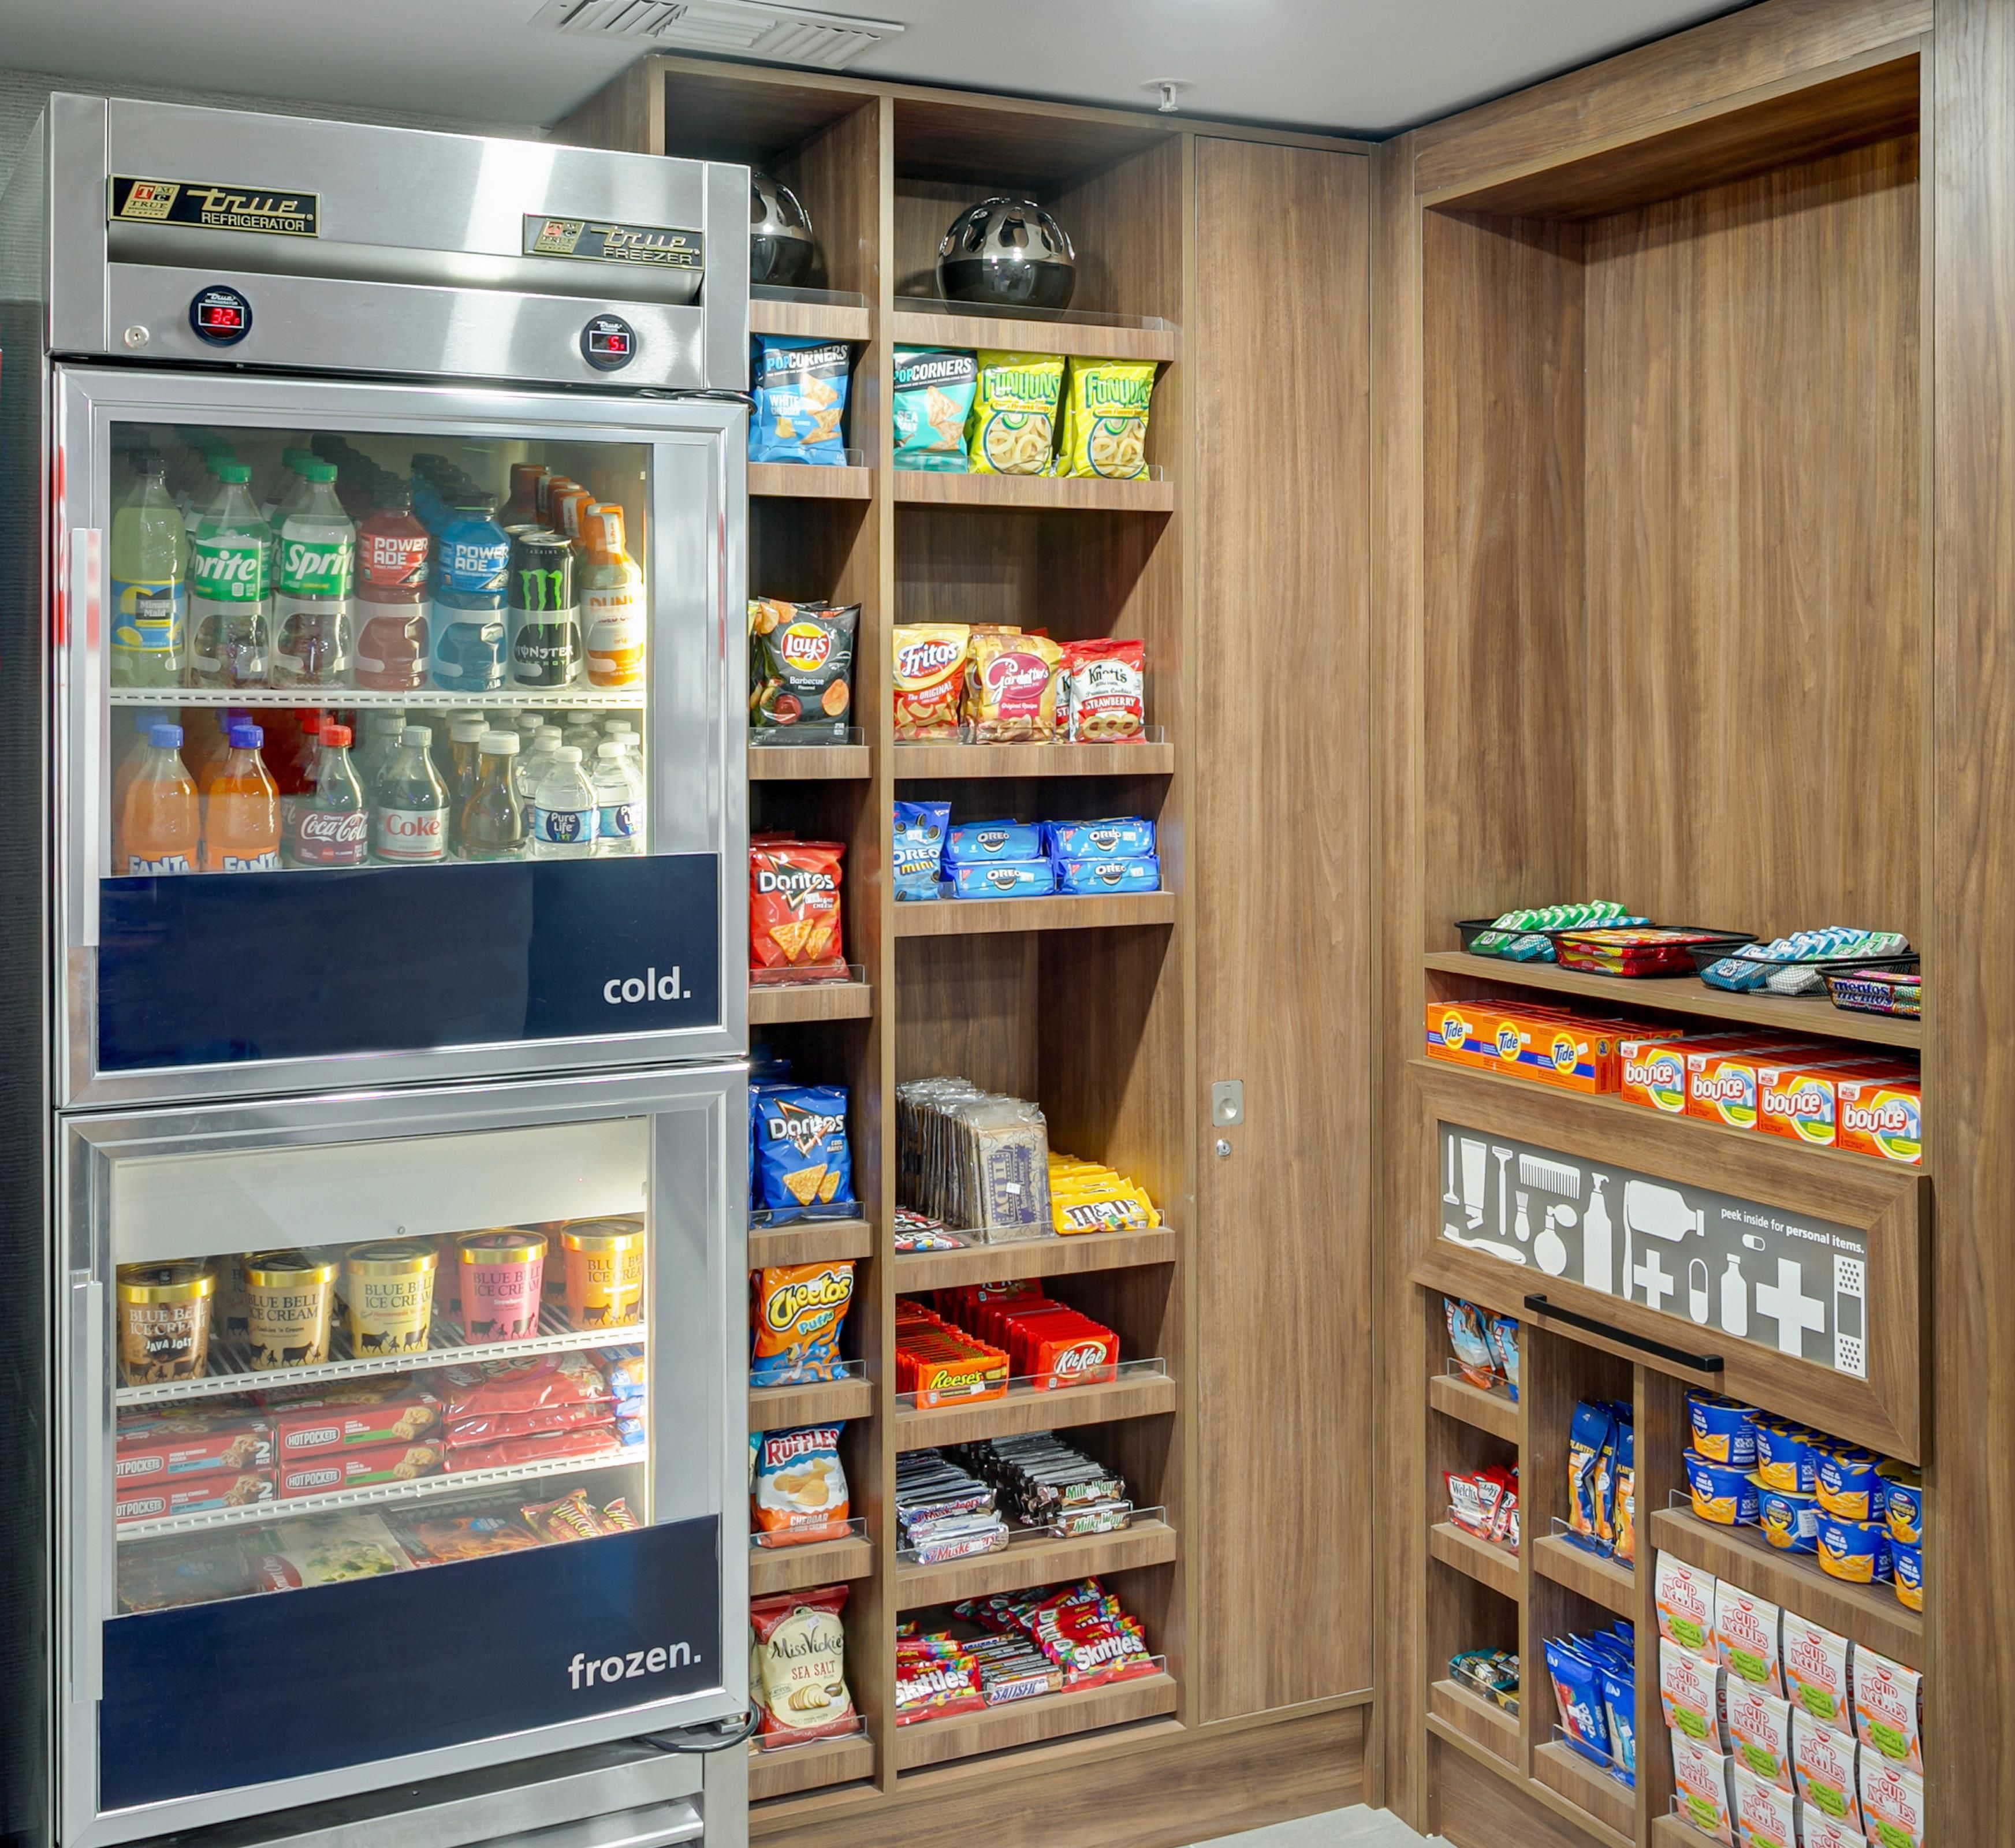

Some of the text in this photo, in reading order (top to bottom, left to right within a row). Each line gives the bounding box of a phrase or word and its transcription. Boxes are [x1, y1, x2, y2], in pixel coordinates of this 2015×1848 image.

[131, 201, 167, 209] TRUE
[201, 211, 305, 232] REFRIGERATOR
[603, 247, 692, 264] FREEZER
[766, 345, 848, 371] POPCORNERS
[897, 411, 918, 423] SEA
[374, 538, 428, 552] POWER
[374, 551, 407, 565] ADE
[455, 557, 487, 572] ADE
[140, 601, 170, 610] Minute
[143, 609, 166, 618] Maid
[785, 635, 827, 662] Lay's
[899, 642, 959, 677] Fritos
[789, 676, 824, 685] Barbecue
[919, 681, 954, 699] ORIGINAL
[1085, 696, 1136, 710] STRAWBERRY
[300, 813, 368, 843] Coca-Cola
[386, 814, 440, 836] Coke
[551, 813, 576, 824] Pure
[554, 822, 572, 833] Life
[977, 831, 1010, 843] OREO
[1089, 830, 1122, 841] OREO
[900, 860, 934, 875] mini
[986, 869, 1021, 881] OREO
[1095, 865, 1126, 876] OREO
[758, 871, 835, 893] Doritos
[603, 965, 691, 1004] cold.
[1835, 981, 1889, 996] mentos
[1444, 1021, 1463, 1040] Tide
[1499, 1031, 1518, 1052] Tide
[1555, 1044, 1574, 1064] Tide
[1625, 1060, 1674, 1086] bounce
[1693, 1074, 1745, 1102] bounce
[1763, 1089, 1822, 1117] bounce
[769, 1114, 844, 1140] Doritos
[1843, 1103, 1907, 1132] bounce
[1721, 1209, 1864, 1254] peek inside for personal items.
[474, 1272, 508, 1284] BLUE
[588, 1272, 609, 1283] ICE
[364, 1284, 403, 1296] BLUE
[474, 1284, 495, 1296] ICE
[284, 1295, 318, 1308] BELL
[366, 1296, 388, 1308] ICE
[769, 1272, 851, 1328] Cheetos
[129, 1310, 167, 1322] BLUE
[267, 1306, 317, 1321] CREAM
[146, 1338, 192, 1352] JAVA JOLT
[930, 1370, 982, 1389] Reese's
[255, 1441, 270, 1459] 2
[766, 1429, 839, 1467] RUFFLES
[258, 1482, 273, 1499] 2
[791, 1514, 828, 1526] CHEDDAR
[1733, 1608, 1759, 1629] CUP
[1722, 1616, 1768, 1649] NOODLES
[771, 1638, 806, 1659] Miss
[1074, 1635, 1143, 1671] Skittles
[1801, 1641, 1827, 1663] CUP
[568, 1641, 702, 1690] frozen.
[792, 1660, 835, 1680] SEA SALT
[1791, 1648, 1837, 1684] NOODLES
[1675, 1667, 1699, 1687] CUP
[1744, 1703, 1768, 1724] CUP
[1734, 1709, 1778, 1745] NOODLES
[1878, 1778, 1906, 1802] CUP
